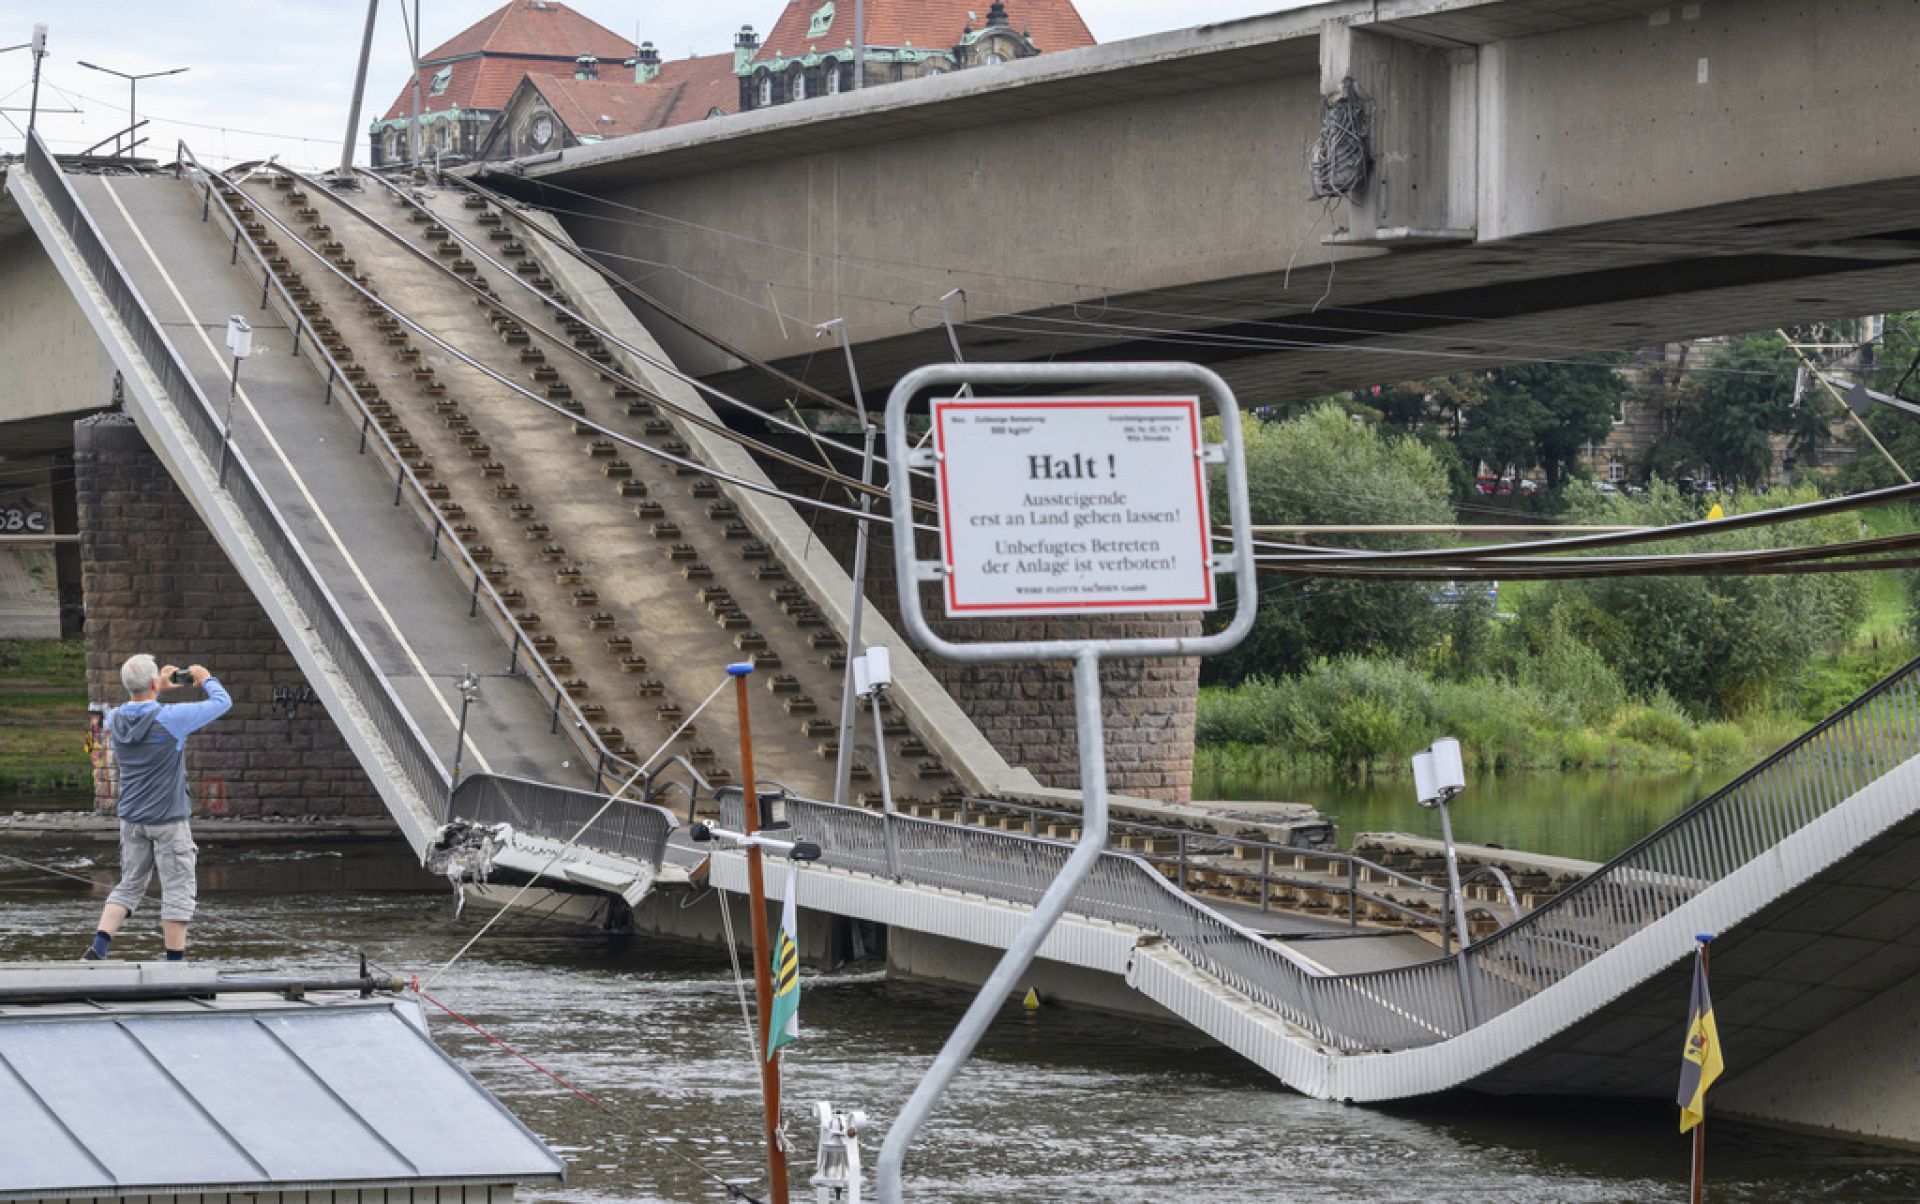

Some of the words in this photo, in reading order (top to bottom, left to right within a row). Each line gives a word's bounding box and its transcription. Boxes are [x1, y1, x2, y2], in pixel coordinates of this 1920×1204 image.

[1028, 453, 1098, 480] Halt
[1108, 454, 1116, 478] !
[1022, 491, 1127, 510] Aussteigende
[970, 513, 1000, 527] erst
[1005, 512, 1025, 526] an
[1030, 509, 1069, 525] Land
[1074, 509, 1122, 529] gehen
[1126, 508, 1181, 523] lassen!
[994, 539, 1087, 557] Unbefugtes
[1090, 538, 1160, 553] Betreten
[982, 558, 1010, 575] der
[1015, 556, 1070, 578] Anlage
[1074, 556, 1093, 571] ist
[1099, 556, 1177, 571] verboten!
